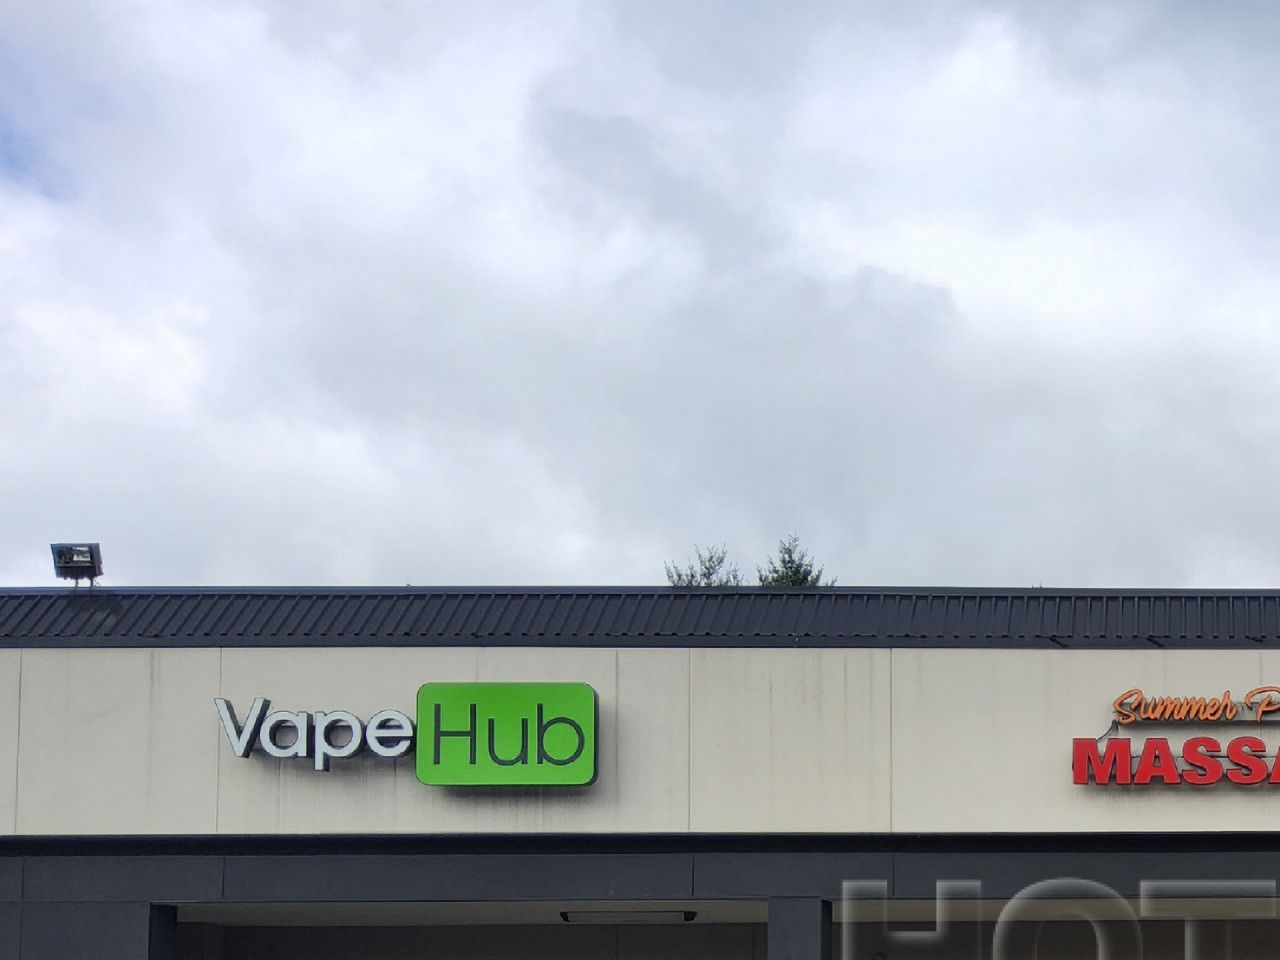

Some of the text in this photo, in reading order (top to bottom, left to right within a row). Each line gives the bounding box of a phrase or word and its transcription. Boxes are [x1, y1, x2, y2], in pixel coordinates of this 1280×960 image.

[214, 697, 586, 772] Vape Hub
[1112, 688, 1237, 725] Summer
